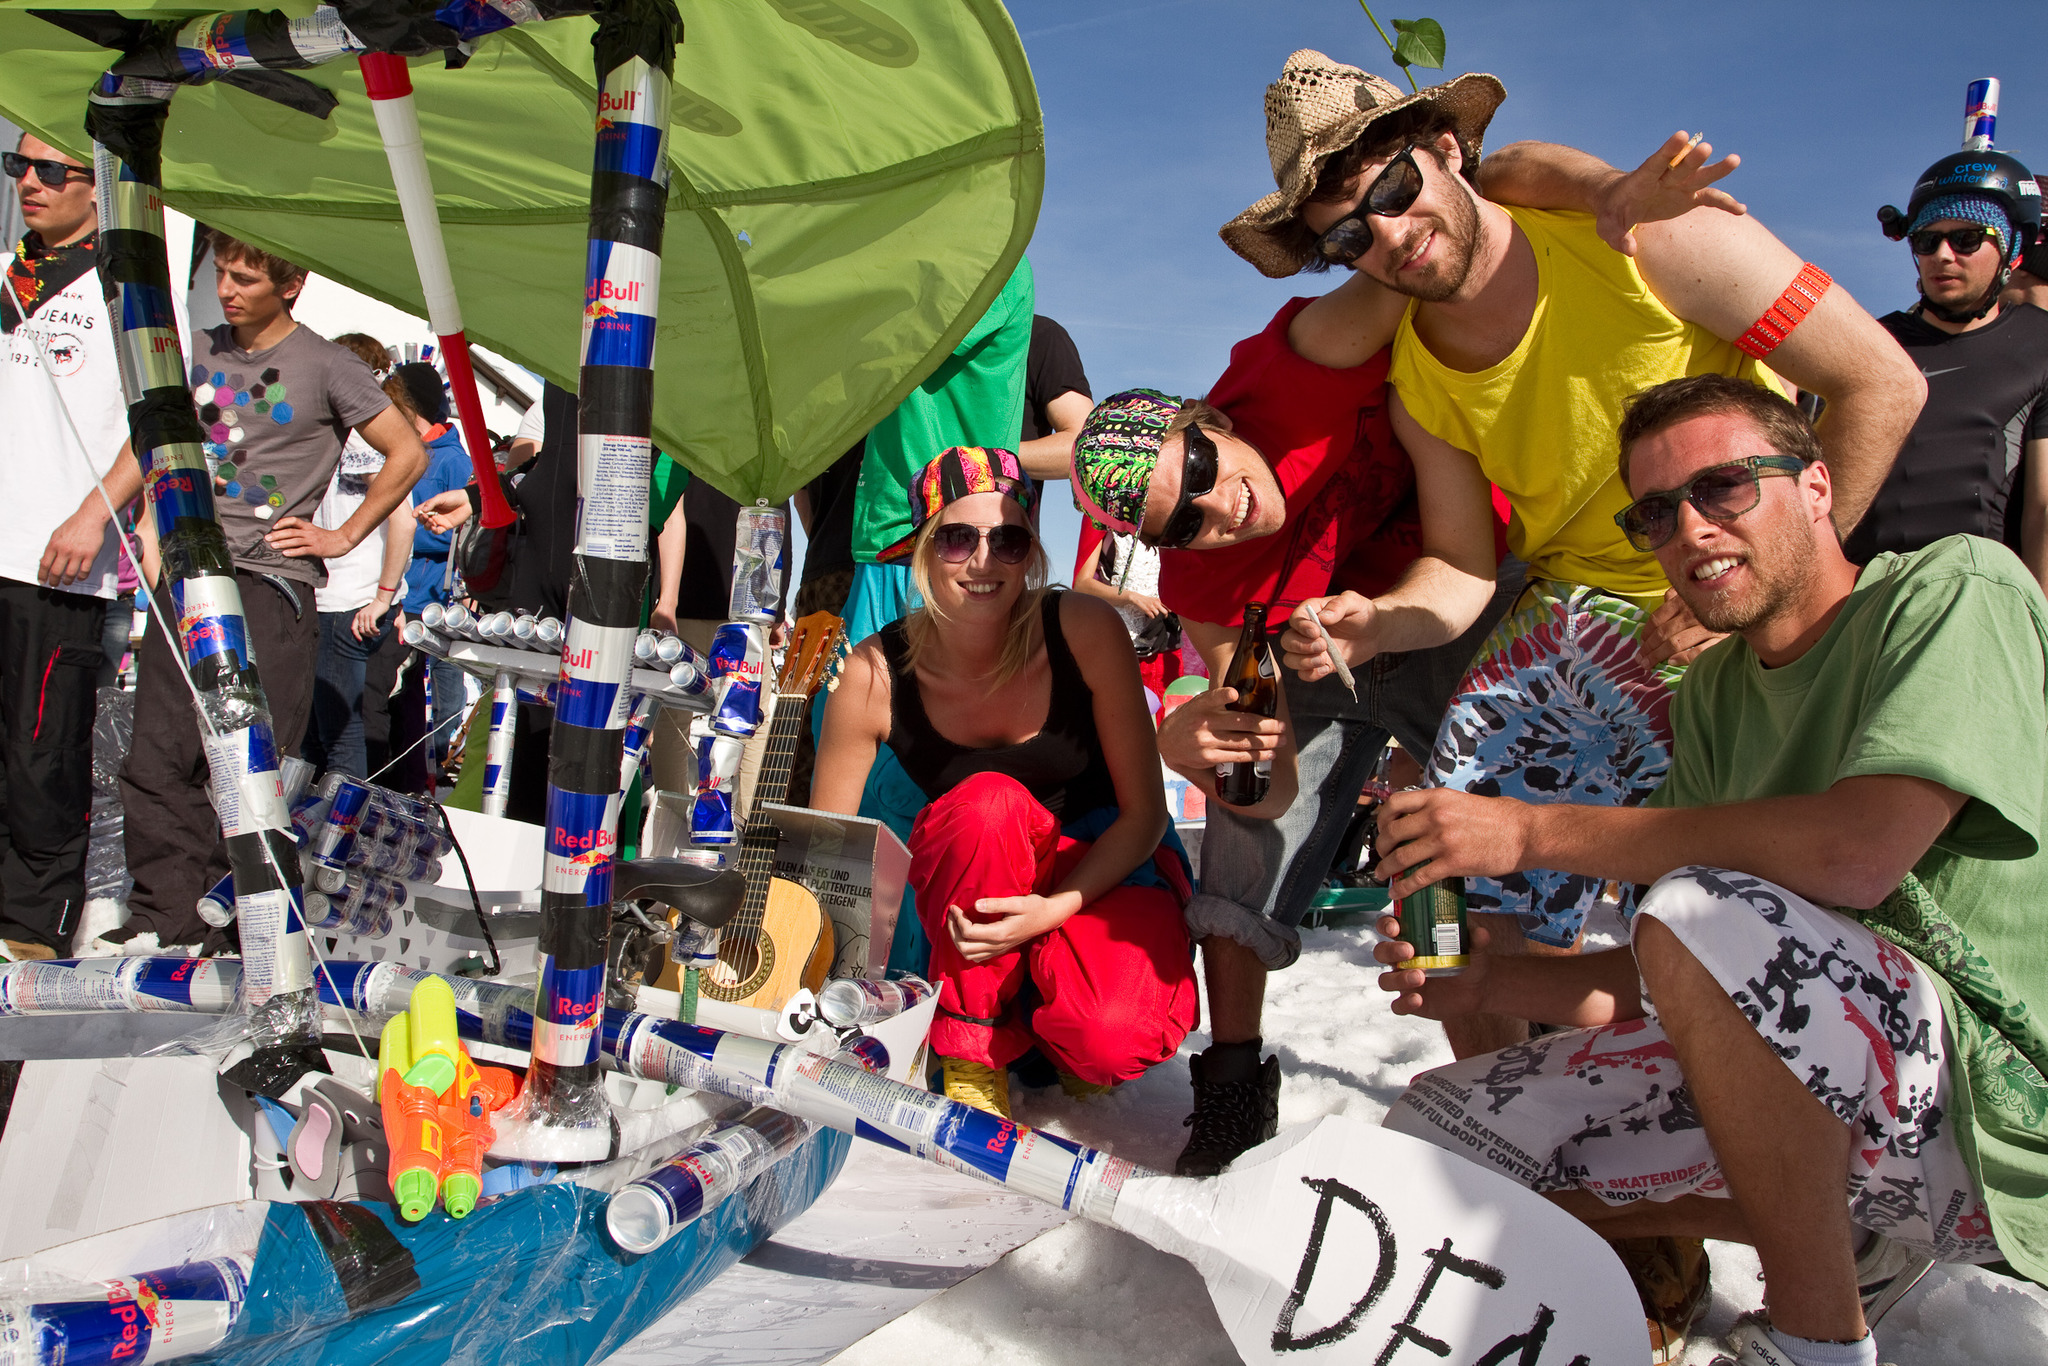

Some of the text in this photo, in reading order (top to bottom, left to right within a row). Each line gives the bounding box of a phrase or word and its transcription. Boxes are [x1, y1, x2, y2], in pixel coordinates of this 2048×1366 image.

[600, 91, 635, 111] Bull
[1954, 163, 1997, 175] crew
[600, 279, 639, 302] Bull
[40, 309, 95, 330] JEANS
[599, 321, 632, 332] DRINK
[156, 475, 194, 500] Red
[187, 624, 225, 649] Red
[562, 645, 592, 669] Bull
[715, 657, 763, 675] Red Bull
[331, 809, 352, 826] Red
[555, 827, 593, 849] Red
[555, 865, 594, 877] ENERGY
[816, 867, 829, 878] EIS
[830, 869, 850, 882] UND
[810, 878, 873, 899] PLATTENTELLER
[820, 892, 857, 908] STEIGEN!
[558, 996, 596, 1016] Red
[560, 1032, 592, 1042] ENERG
[1022, 1132, 1038, 1160] ENERG
[1421, 1106, 1488, 1152] FULLBODY
[1486, 1147, 1539, 1183] CONTES
[1463, 1115, 1542, 1172] SKATERIDER
[687, 1157, 716, 1187] Bull
[1609, 1161, 1709, 1190] SKATERIDER
[162, 1292, 176, 1345] ENERGY
[109, 1303, 140, 1361] Red
[1750, 1340, 1781, 1366] adida
